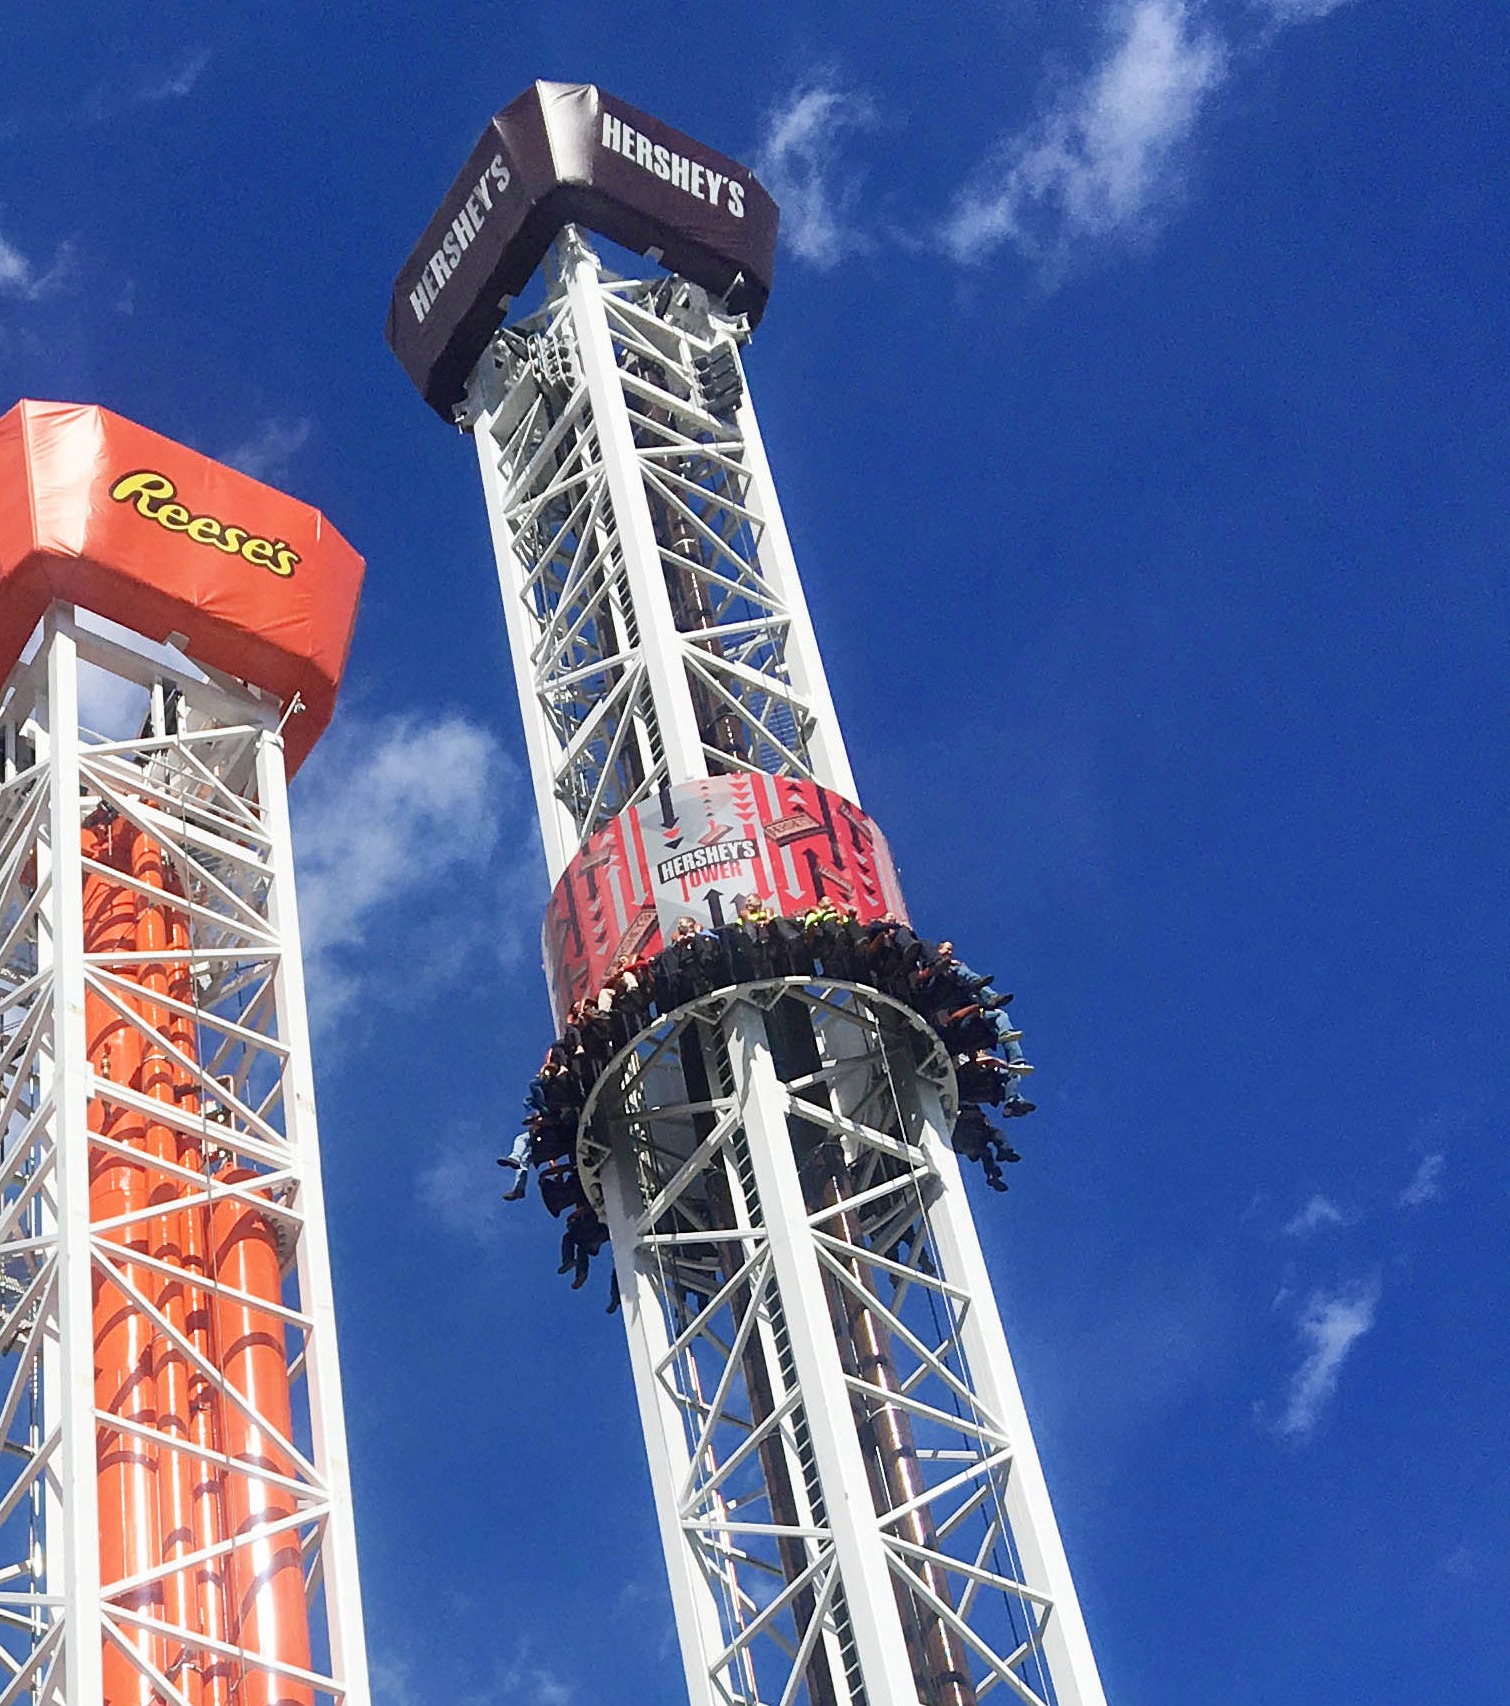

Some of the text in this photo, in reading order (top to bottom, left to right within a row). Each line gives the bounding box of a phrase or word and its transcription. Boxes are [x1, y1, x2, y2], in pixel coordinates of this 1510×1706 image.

[602, 112, 746, 218] HERSHEY'S
[409, 154, 512, 324] HERSHEY'S
[111, 469, 302, 578] Reese's
[661, 840, 756, 881] HERSHEY'S
[678, 860, 744, 903] TOWER
